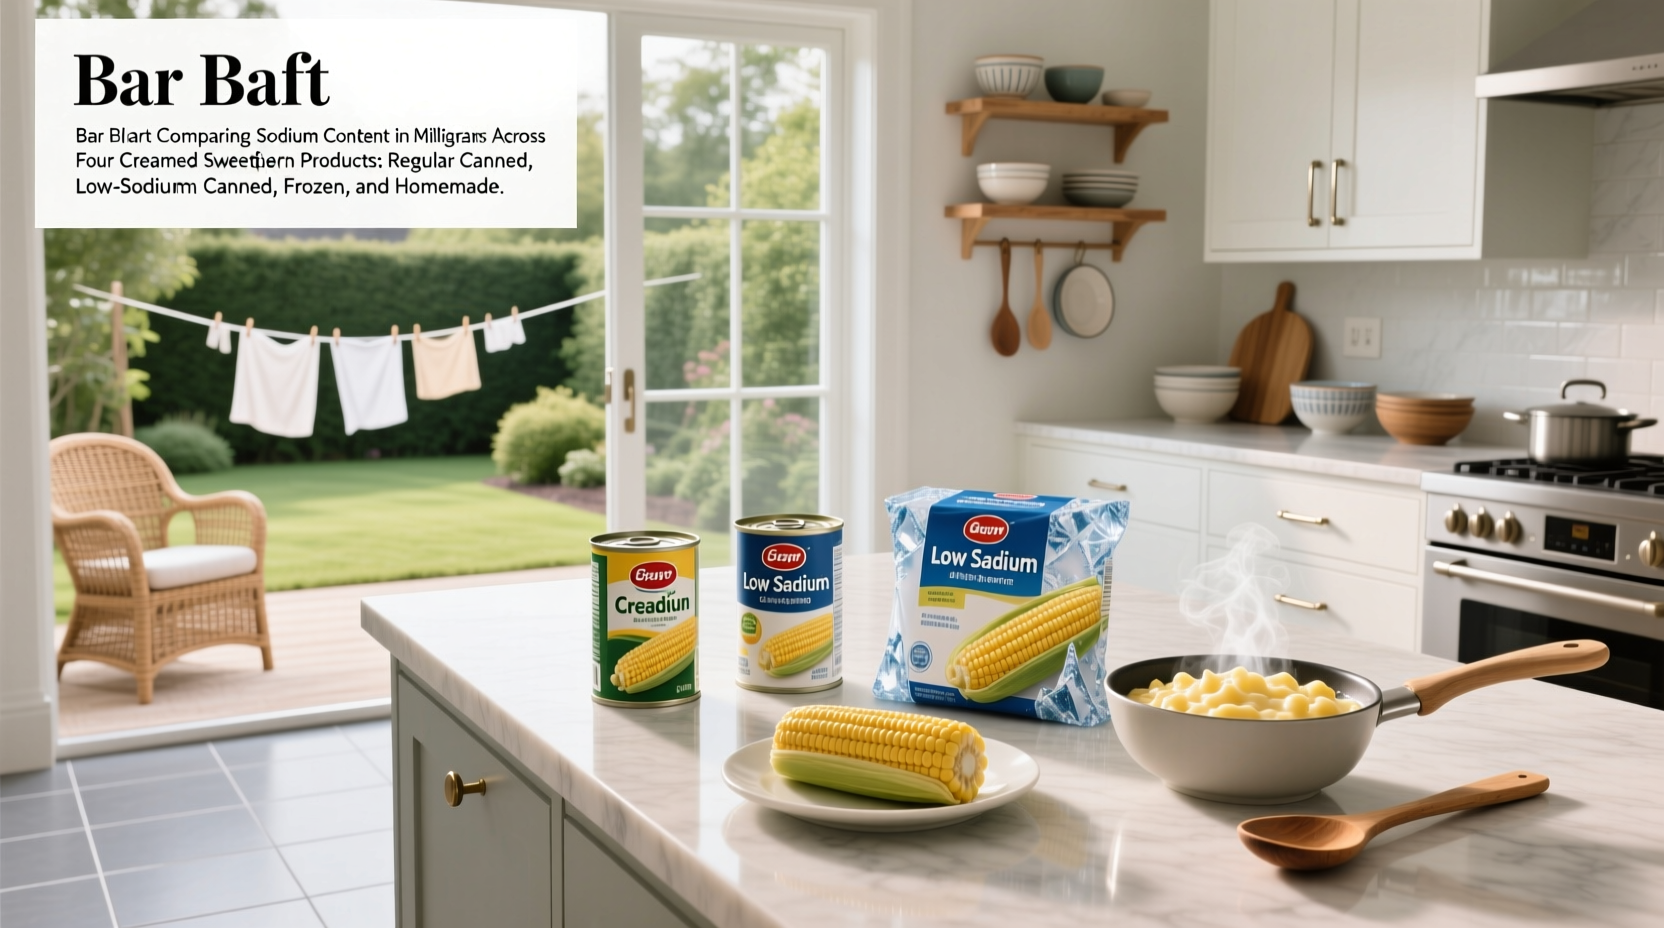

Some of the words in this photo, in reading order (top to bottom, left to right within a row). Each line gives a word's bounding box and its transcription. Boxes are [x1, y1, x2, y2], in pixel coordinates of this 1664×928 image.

[931, 546, 967, 567] Low
[970, 548, 1038, 574] Sadium
[743, 571, 770, 592] Low
[773, 574, 830, 593] Sadium
